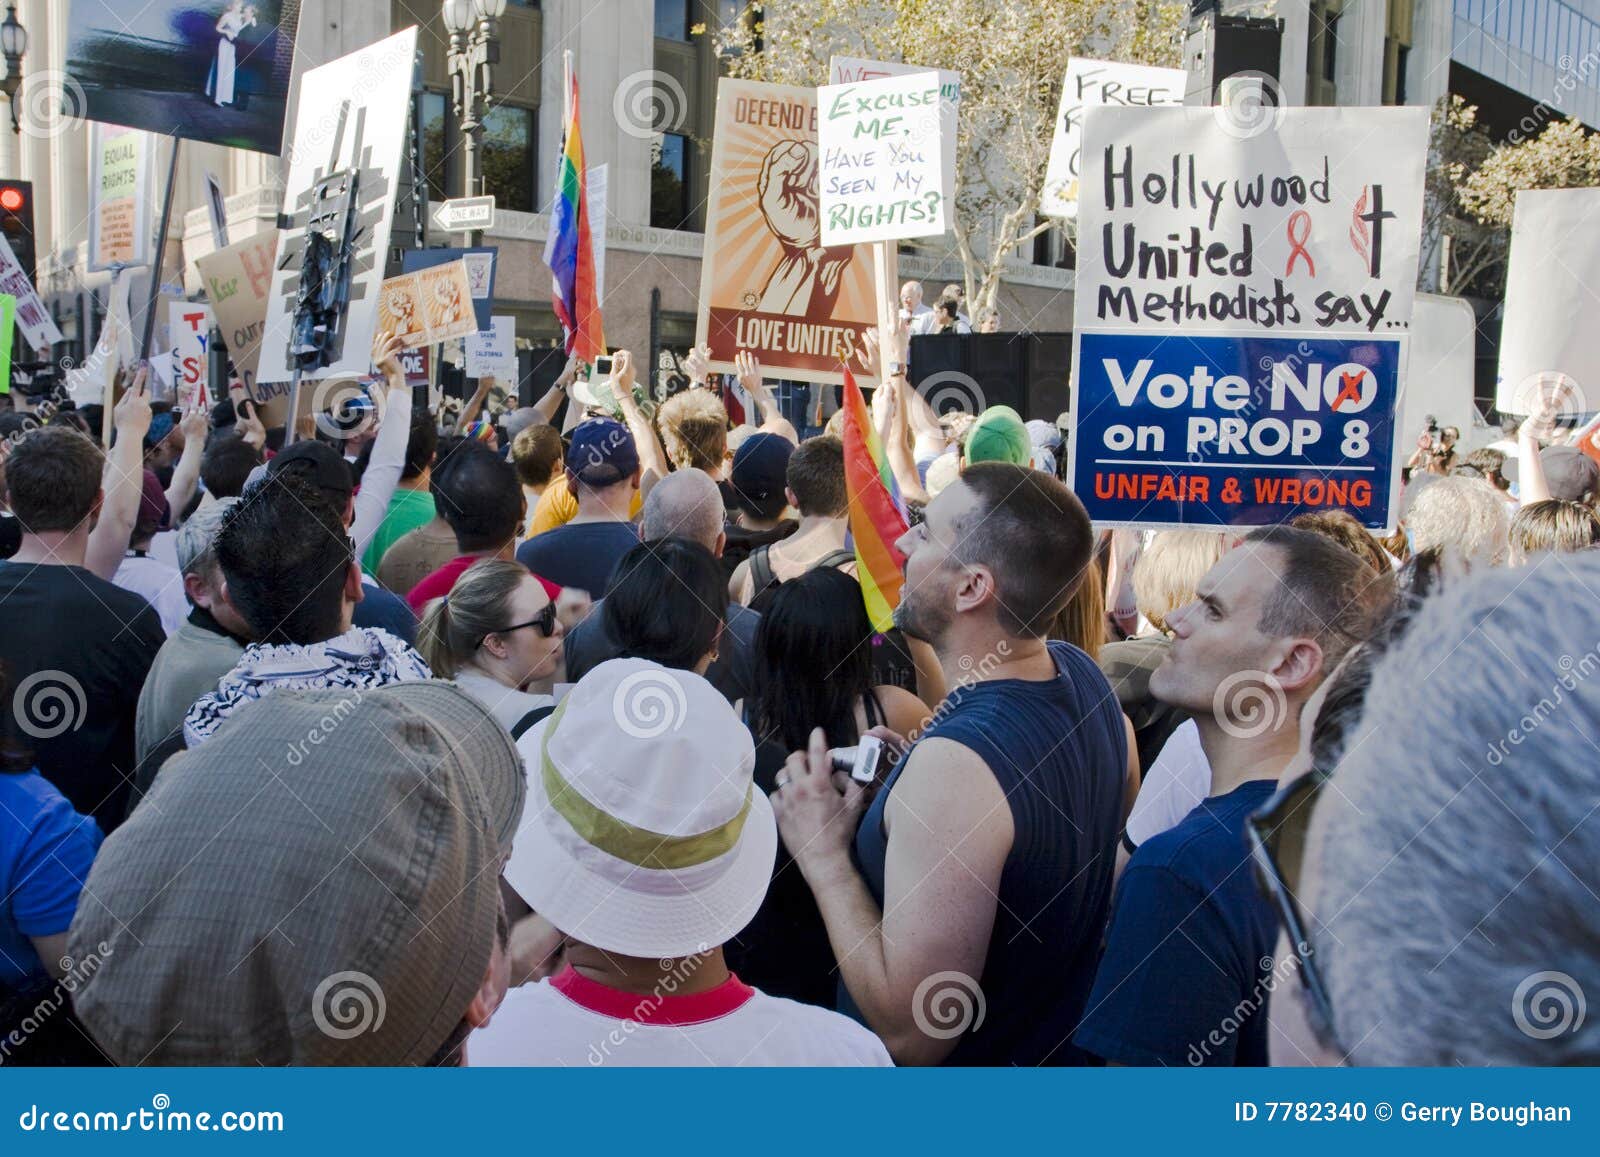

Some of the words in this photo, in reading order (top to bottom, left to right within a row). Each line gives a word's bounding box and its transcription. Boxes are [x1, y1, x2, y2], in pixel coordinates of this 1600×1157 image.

[735, 97, 804, 130] DEFEND
[104, 143, 135, 166] EQUAL
[824, 147, 876, 170] HAVE
[102, 168, 136, 190] RIGHTS
[826, 176, 877, 196] SEEN
[1104, 143, 1331, 231] Hollywood
[450, 208, 468, 220] ONE
[469, 207, 488, 218] WAY
[828, 191, 941, 231] RIGHTS?
[1103, 222, 1252, 279] United
[735, 317, 785, 351] LOVE
[786, 321, 856, 360] UNITES
[1102, 358, 1250, 411] Vote
[1103, 424, 1165, 452] on
[1187, 416, 1322, 457] PROP
[1341, 419, 1371, 459] 8
[1095, 473, 1210, 503] UNFAIR
[1221, 477, 1242, 504] &
[1255, 478, 1372, 507] WRONG
